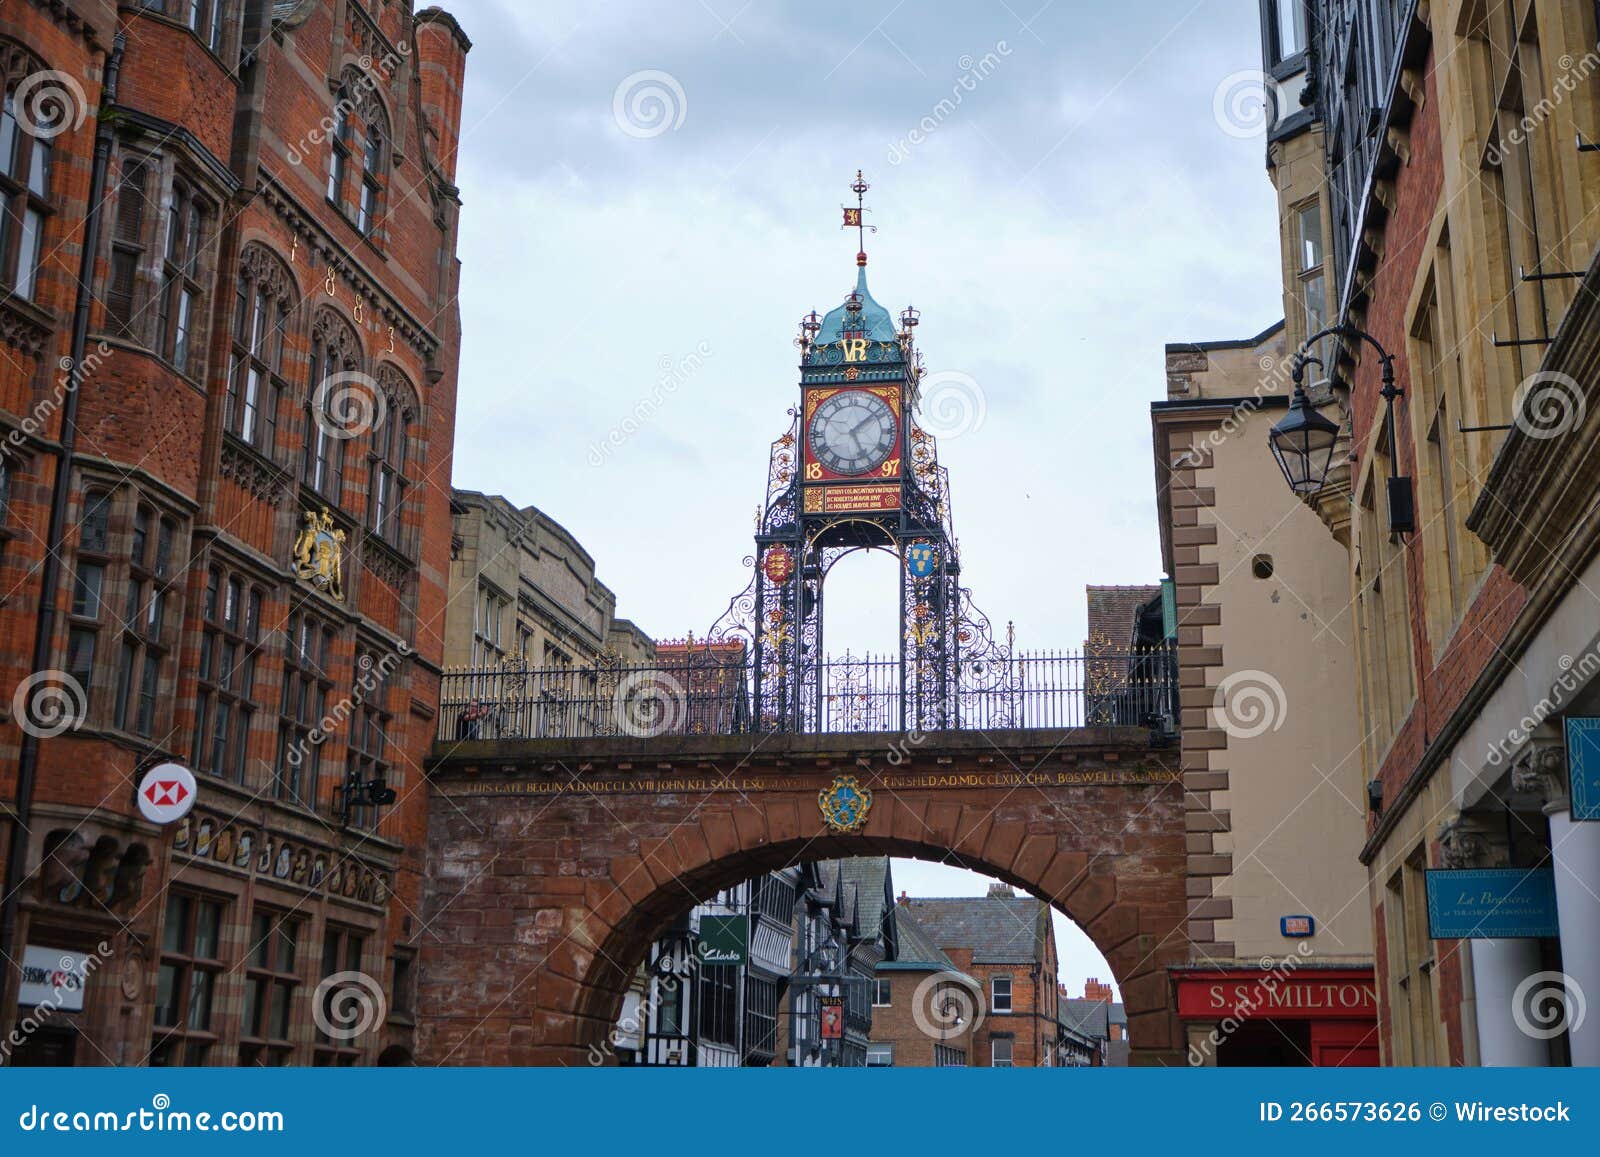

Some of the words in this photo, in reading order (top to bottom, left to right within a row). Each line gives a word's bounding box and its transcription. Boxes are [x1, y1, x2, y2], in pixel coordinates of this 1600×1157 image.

[841, 338, 867, 362] VR
[806, 462, 823, 479] 18
[881, 458, 901, 477] 97
[703, 949, 741, 961] Clarks
[23, 966, 53, 986] HSBC
